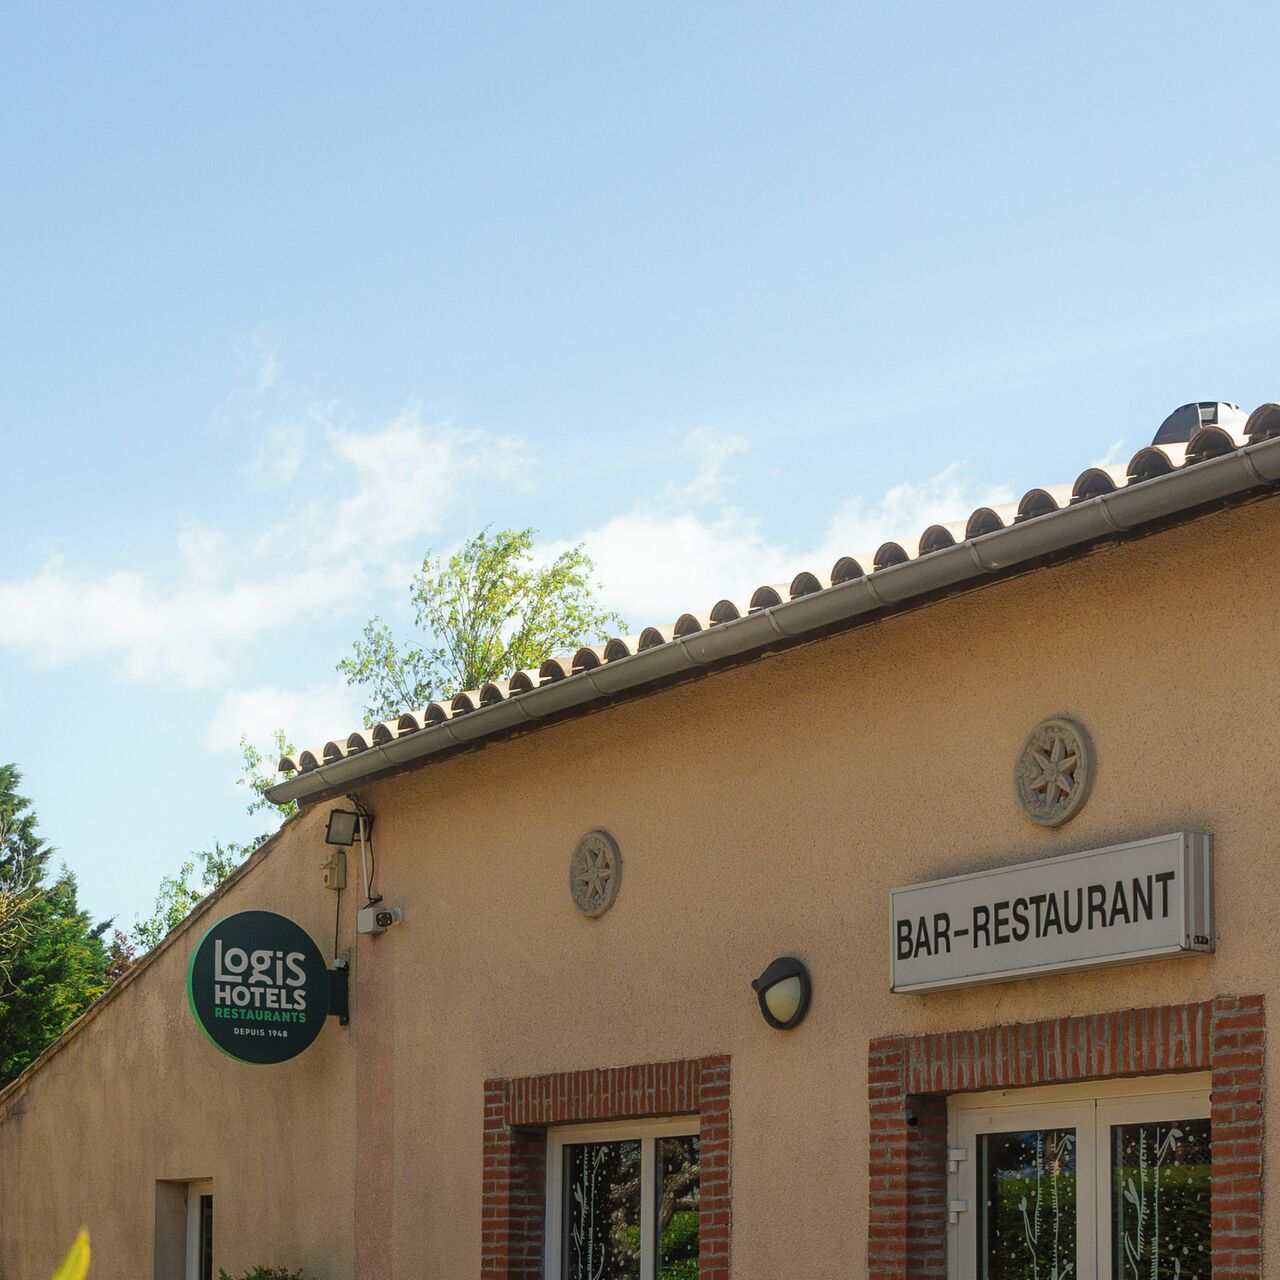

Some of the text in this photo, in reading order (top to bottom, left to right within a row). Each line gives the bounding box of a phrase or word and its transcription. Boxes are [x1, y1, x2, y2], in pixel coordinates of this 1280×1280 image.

[896, 871, 1176, 961] BAR-RESTAURANT
[214, 984, 307, 1010] HOTELS
[214, 1007, 306, 1023] RESTAURANTS
[233, 1027, 288, 1038] DEPUIS 1948
